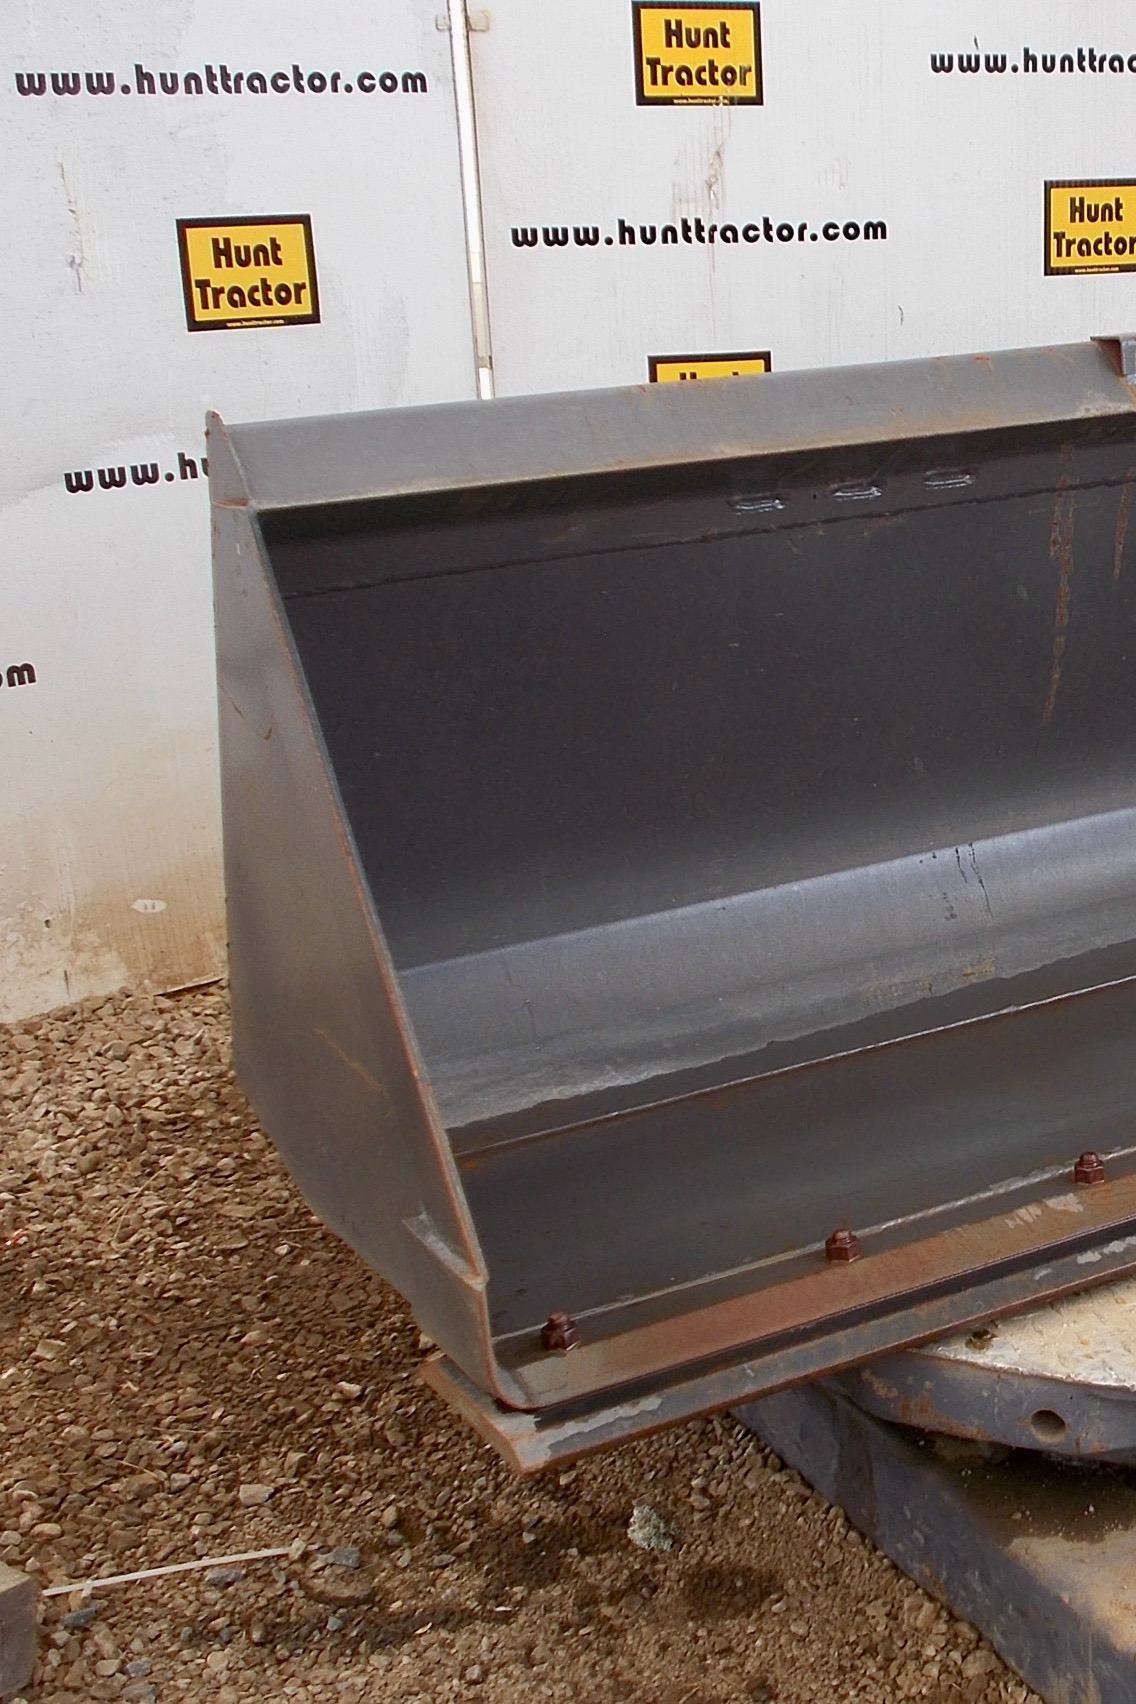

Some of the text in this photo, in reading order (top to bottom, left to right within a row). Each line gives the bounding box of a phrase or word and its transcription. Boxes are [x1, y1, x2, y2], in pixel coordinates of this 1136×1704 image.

[664, 18, 731, 49] Hunt
[15, 63, 428, 97] www.hunttractor.com
[645, 56, 752, 87] Tractor
[1069, 196, 1123, 223] Hunt
[511, 216, 887, 248] www.hunttractor.com
[211, 236, 283, 269] Hunt
[194, 277, 307, 310] Tractor
